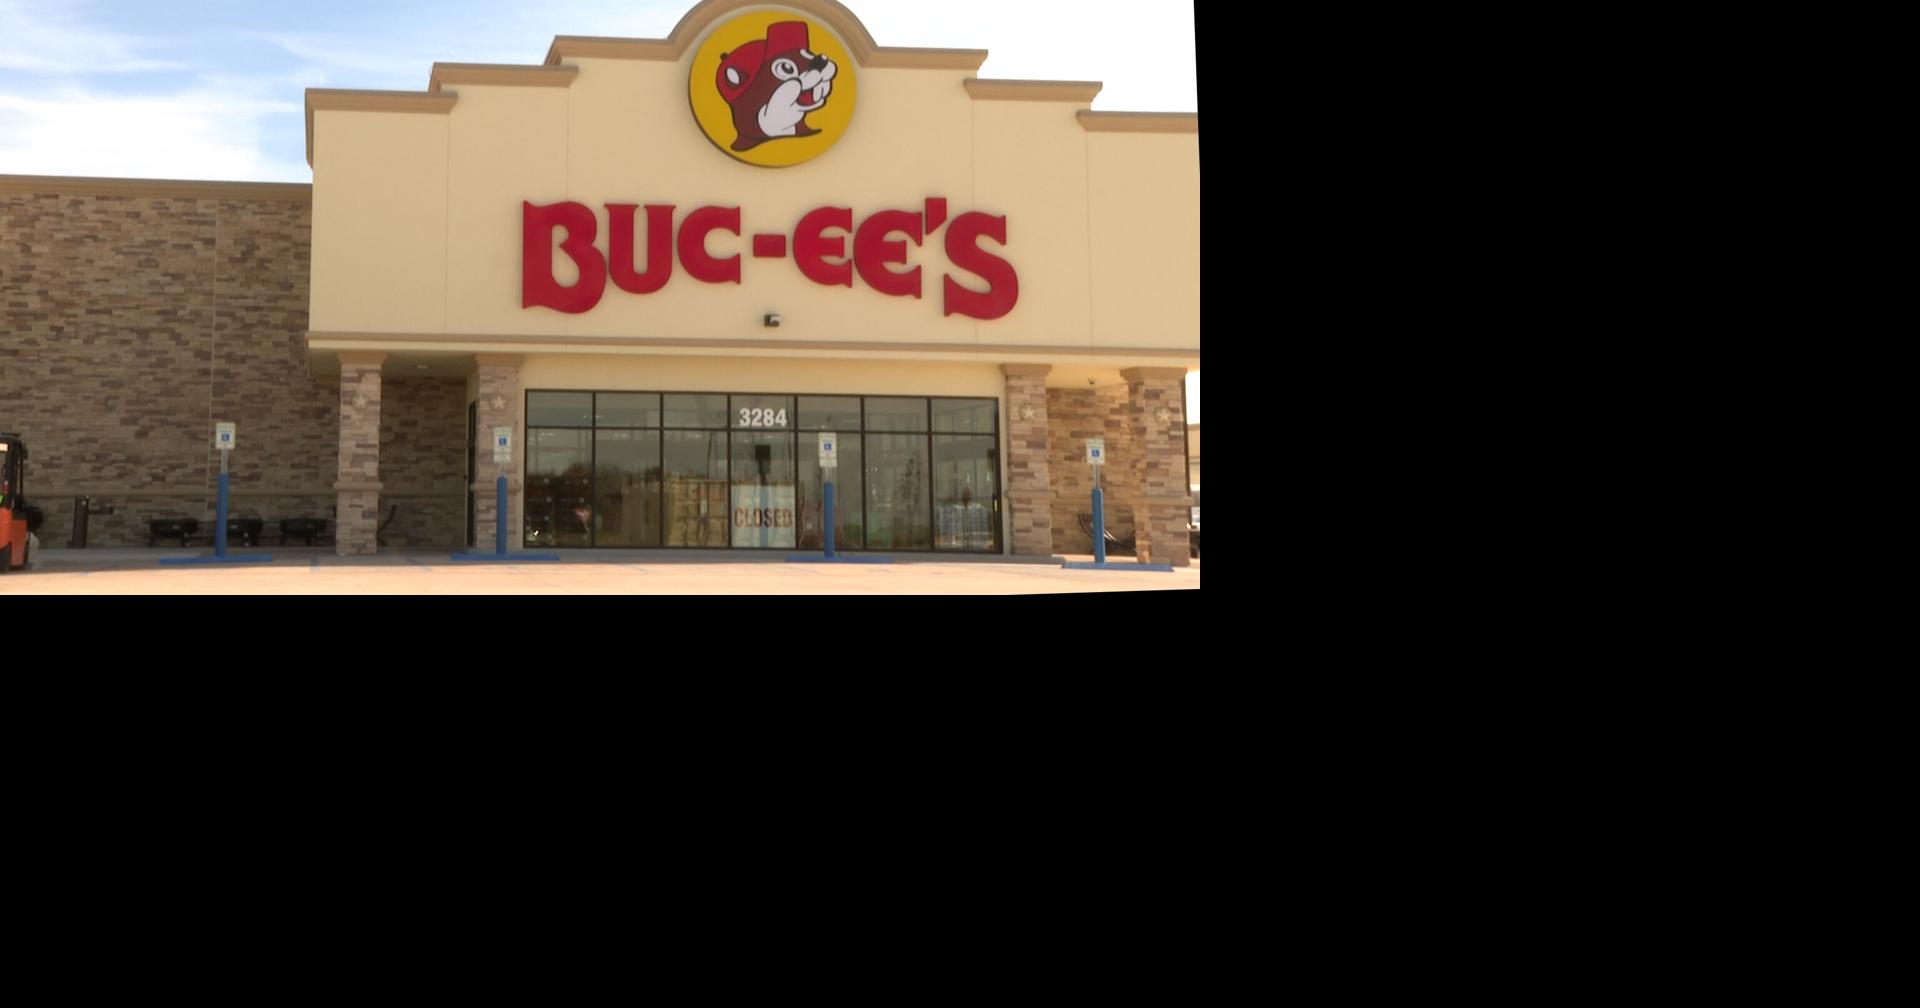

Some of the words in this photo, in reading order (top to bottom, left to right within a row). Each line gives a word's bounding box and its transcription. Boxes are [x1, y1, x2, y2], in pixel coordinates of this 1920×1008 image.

[522, 197, 1020, 320] BUC-EE'S
[739, 407, 788, 427] 3284
[734, 507, 793, 529] CLOSED
